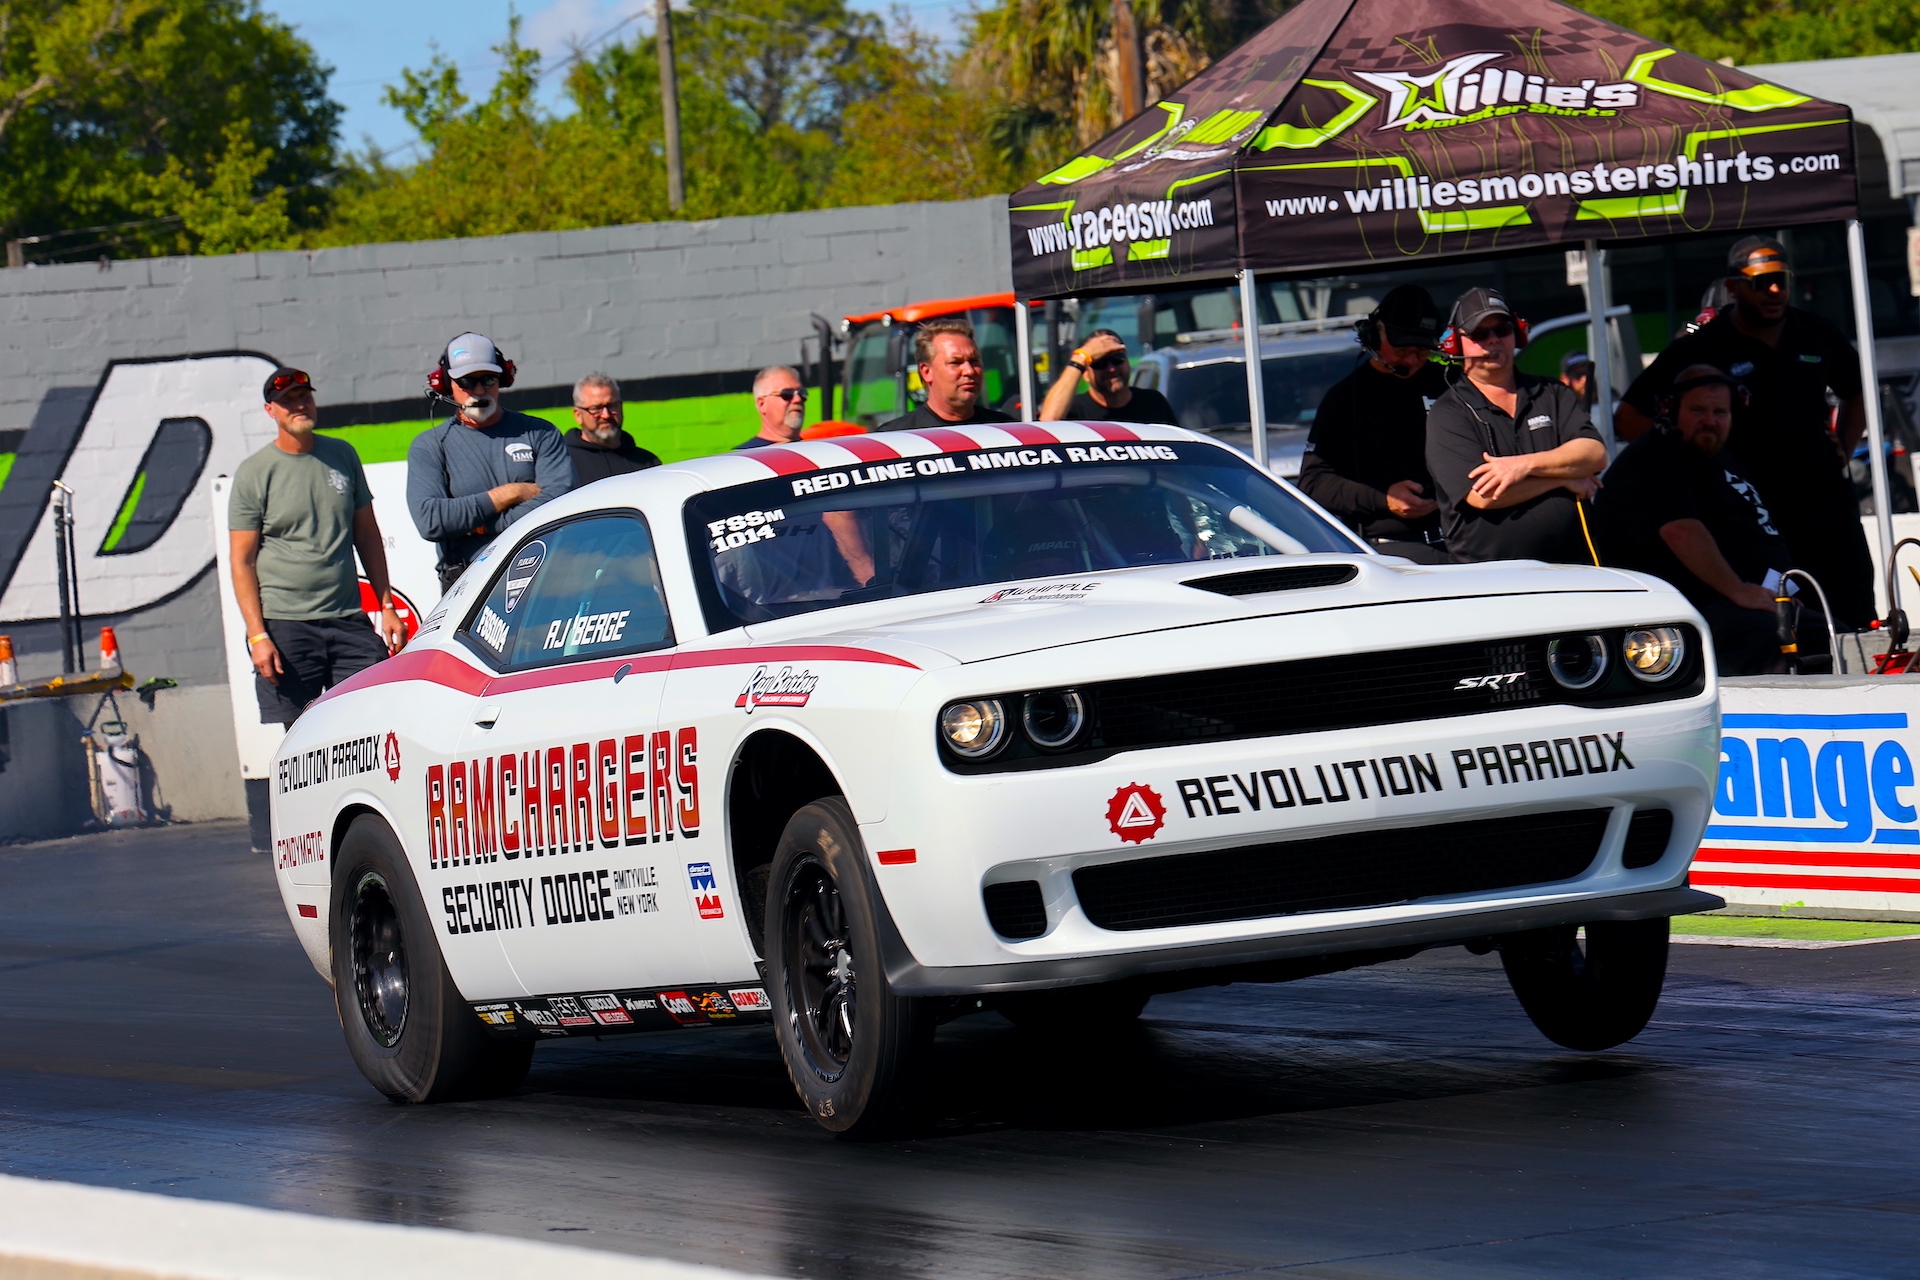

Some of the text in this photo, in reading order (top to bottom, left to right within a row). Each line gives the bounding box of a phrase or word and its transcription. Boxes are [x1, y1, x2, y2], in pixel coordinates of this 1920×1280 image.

[791, 445, 1179, 497] RED LINE OIL NMCA RACING
[711, 524, 776, 553] 1014
[1028, 540, 1078, 553] IMPACT
[1012, 582, 1101, 596] WHIPPLE
[543, 610, 631, 650] AJ BERGE
[1453, 671, 1527, 690] SRT
[279, 733, 380, 795] REVOLUTION PARADOX
[1175, 731, 1635, 818] REVOLUTION PARADOX
[426, 726, 701, 870] RAMCHARGERS
[277, 830, 324, 870] CANDYMATIC
[613, 866, 659, 890] AMITYVILLE,
[442, 869, 615, 935] SECURITY DODGE
[616, 893, 660, 916] NEW YORK
[584, 997, 618, 1011] LINCOLN
[660, 993, 696, 1015] Coan
[731, 991, 760, 1007] COMP
[523, 1010, 559, 1026] WELD
